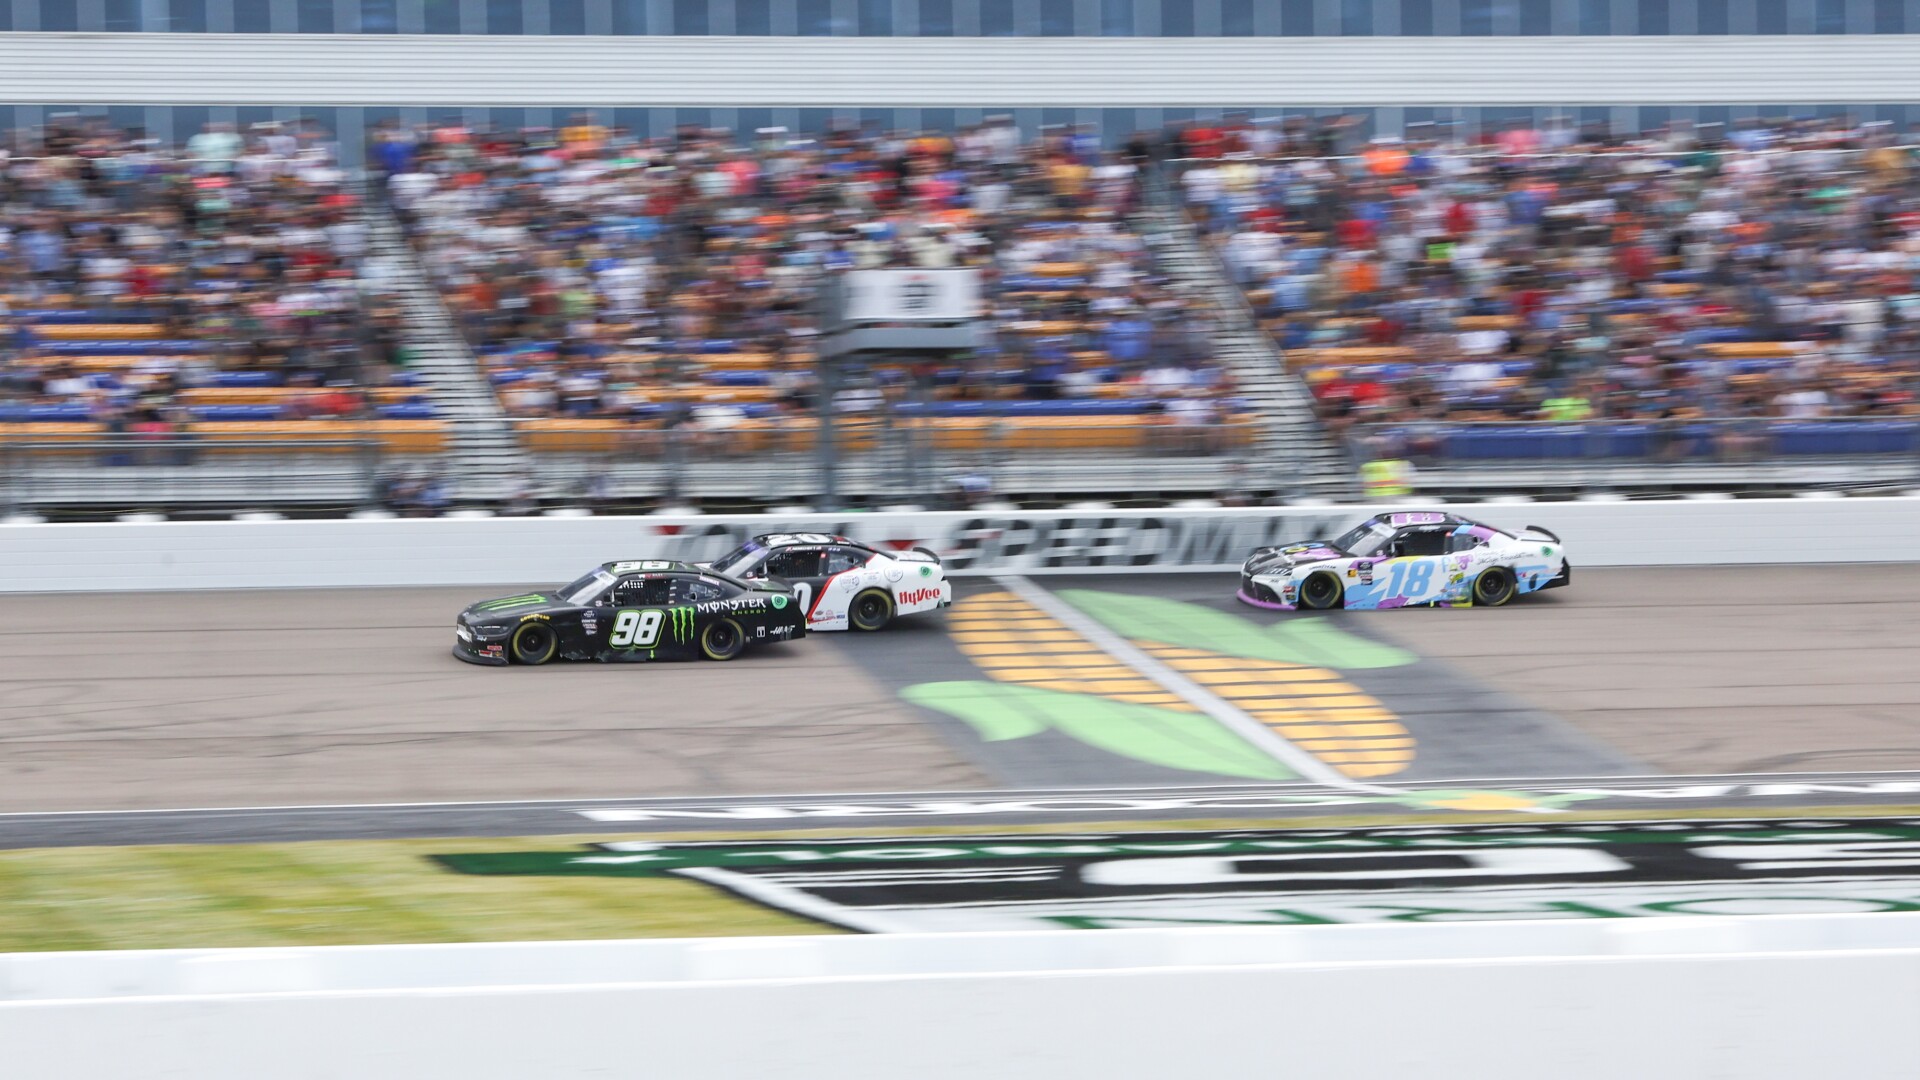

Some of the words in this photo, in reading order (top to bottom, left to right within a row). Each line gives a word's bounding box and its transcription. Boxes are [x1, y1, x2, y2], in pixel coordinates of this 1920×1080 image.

[1386, 560, 1435, 598] 18
[697, 598, 767, 614] MONSTER
[611, 611, 665, 647] 98
